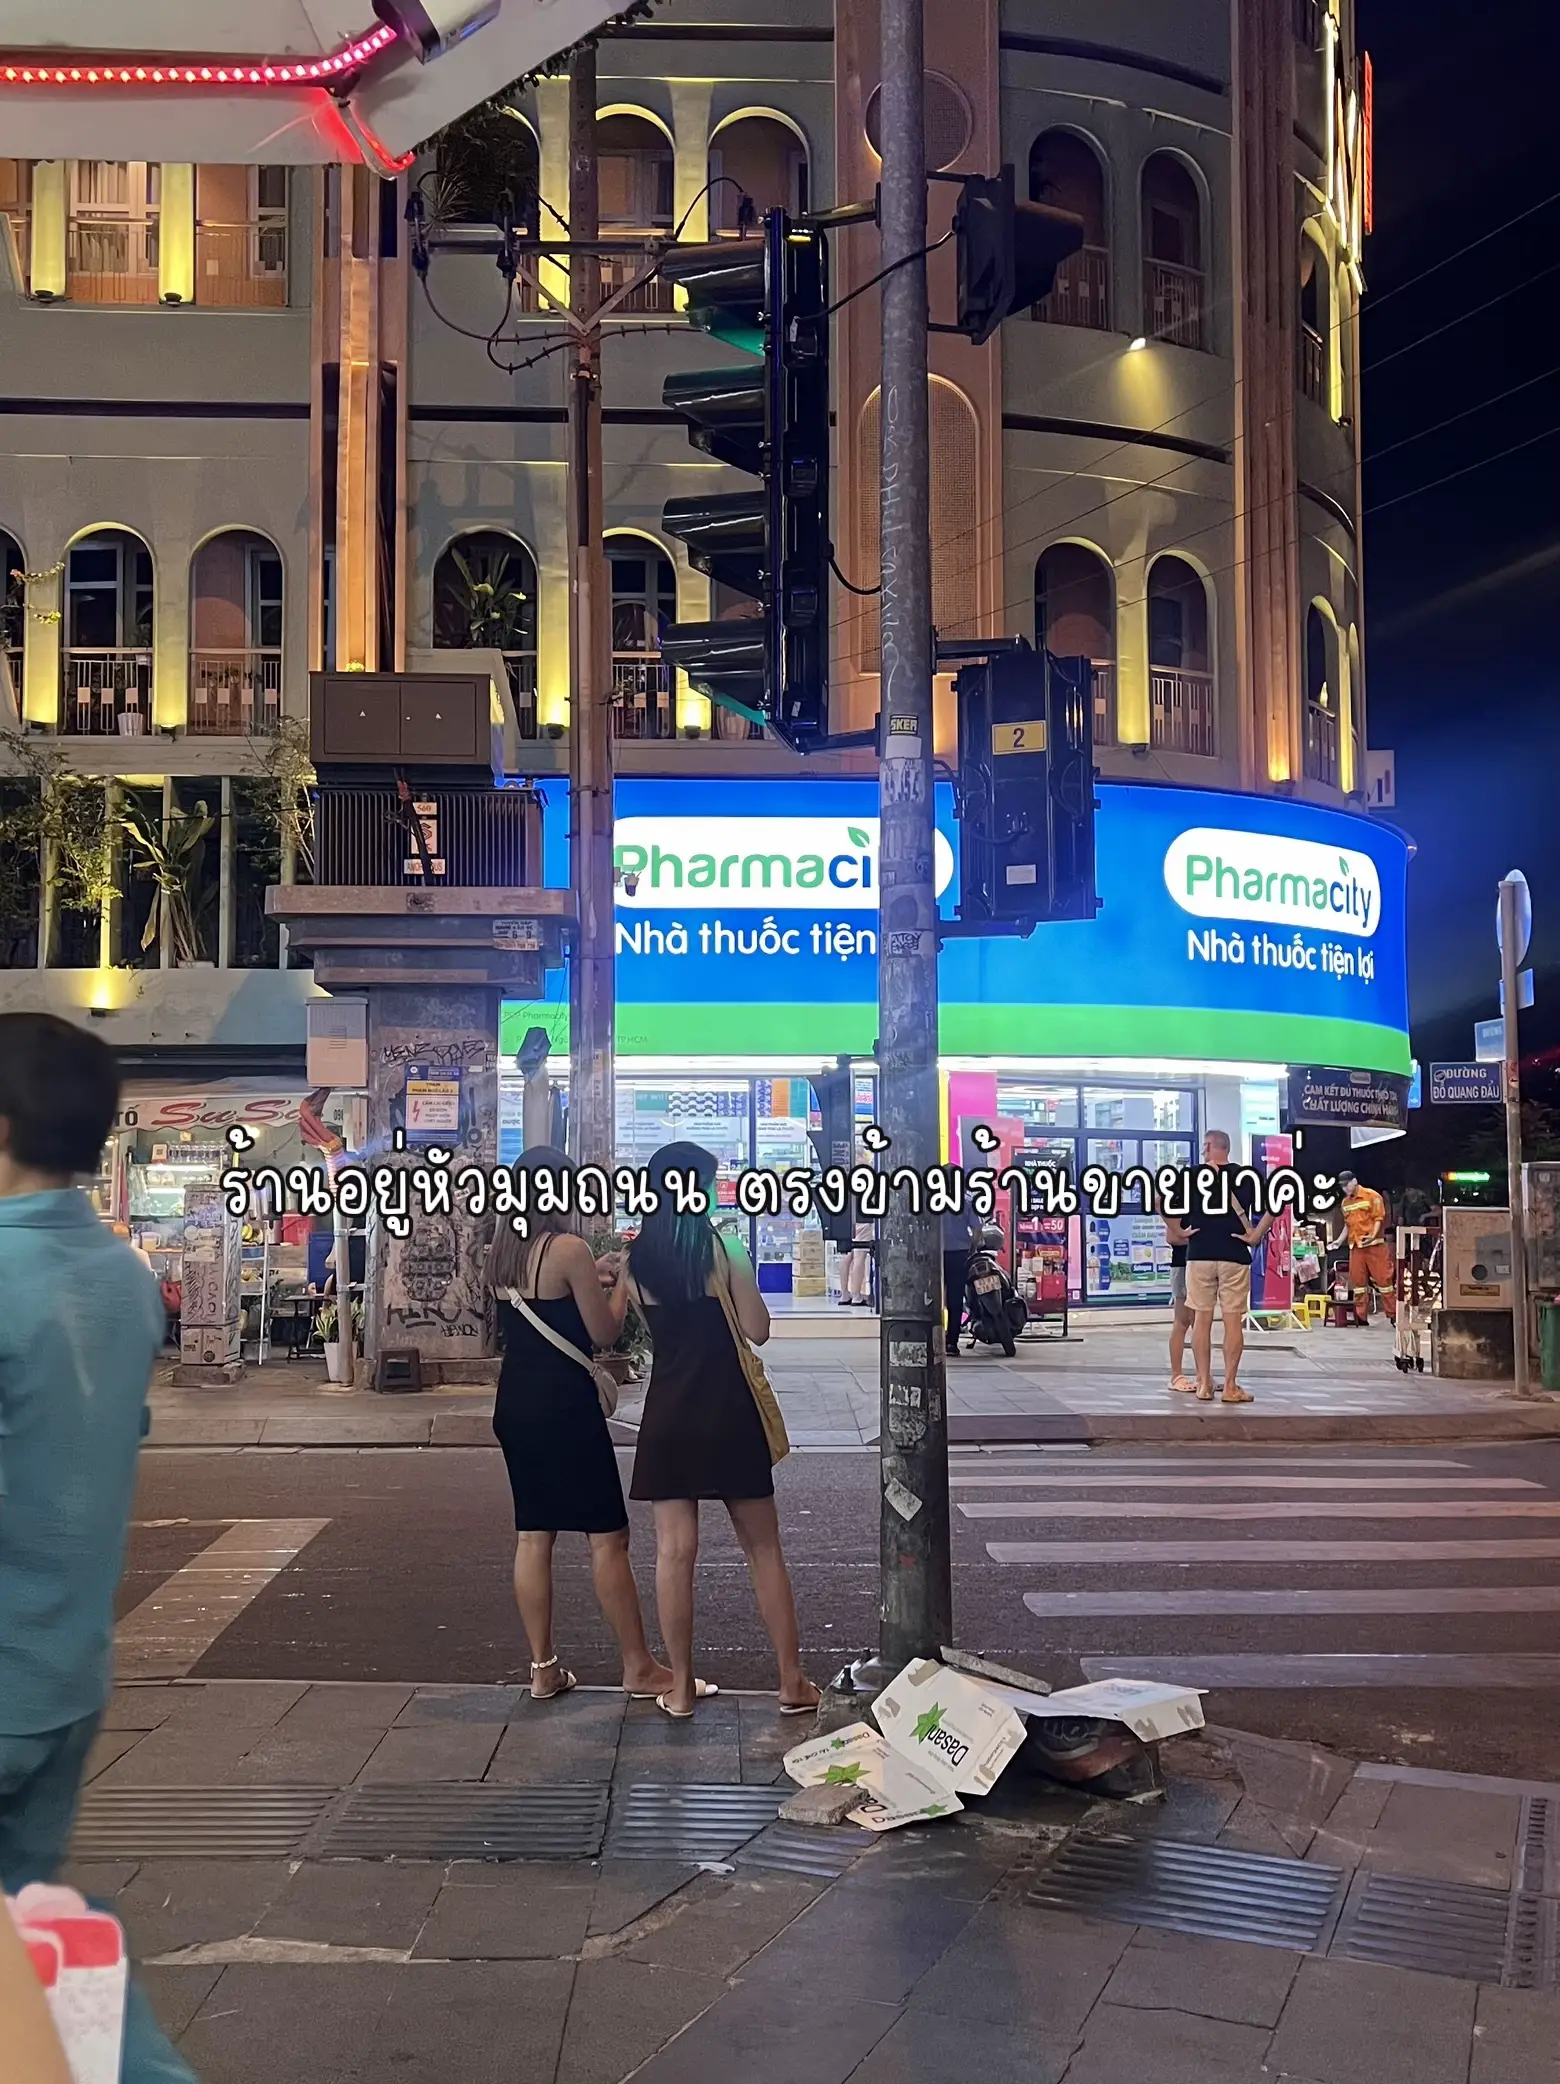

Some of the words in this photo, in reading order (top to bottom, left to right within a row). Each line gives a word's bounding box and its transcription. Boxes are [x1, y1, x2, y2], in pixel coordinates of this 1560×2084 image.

[1013, 727, 1025, 748] 2
[614, 827, 872, 889] Pharmaci
[1186, 854, 1372, 928] Pharmacity
[614, 920, 688, 955] Nhà
[698, 916, 800, 955] thuốc
[809, 921, 876, 962] tiện
[1187, 928, 1245, 965] Nhà
[1251, 932, 1317, 971] thuốc
[1321, 942, 1355, 981] tiện
[1357, 946, 1375, 985] lợi
[1324, 1083, 1340, 1096] KẾT
[1330, 1099, 1359, 1117] LƯỢNG
[1447, 1085, 1480, 1099] QUANG
[919, 1724, 969, 1767] Dasani
